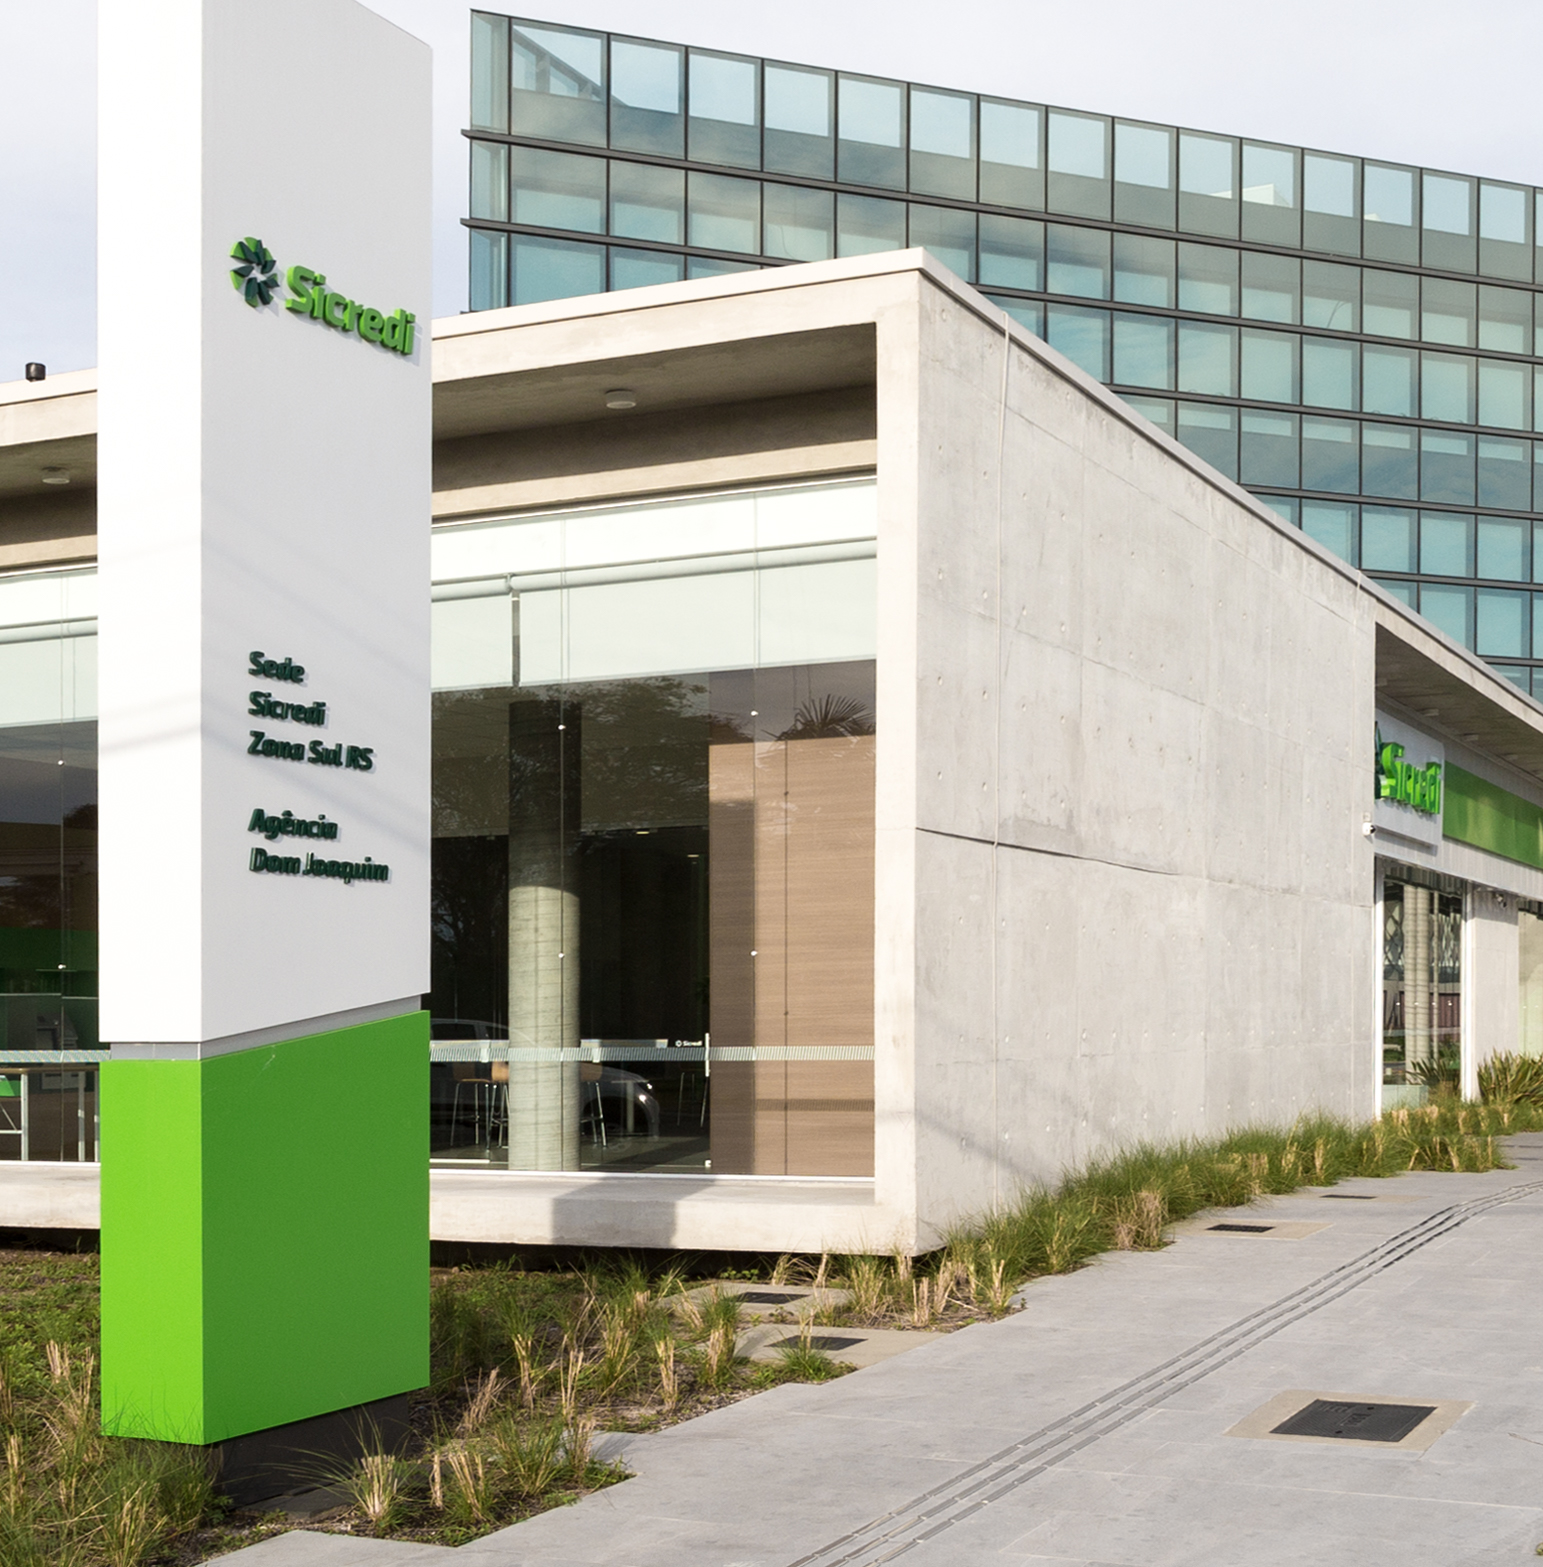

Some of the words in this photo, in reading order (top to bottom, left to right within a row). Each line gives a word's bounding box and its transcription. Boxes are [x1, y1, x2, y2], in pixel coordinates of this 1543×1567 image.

[285, 265, 416, 355] Sicredi
[248, 651, 305, 683] Sede
[248, 691, 326, 726] Sicredi
[248, 730, 305, 761] Zona
[308, 740, 343, 767] Sul
[345, 744, 374, 771] RS
[248, 808, 338, 840] Agência
[249, 847, 301, 875] Dom
[302, 852, 389, 884] Joaquim
